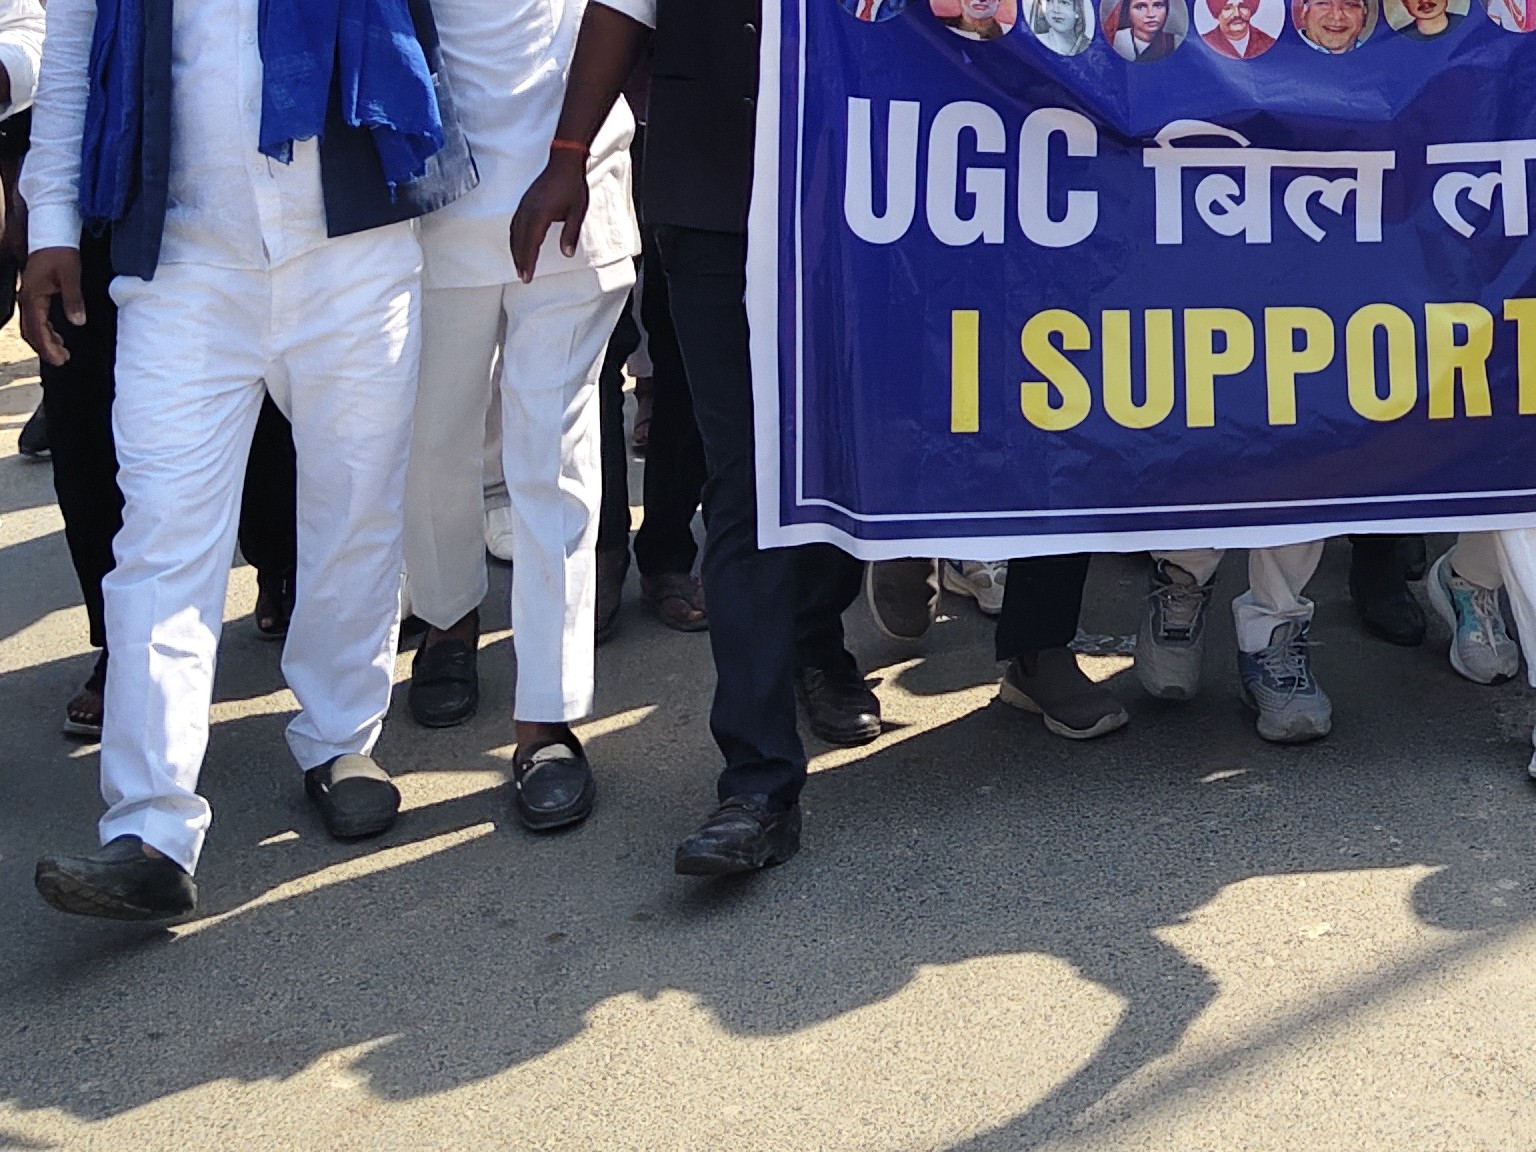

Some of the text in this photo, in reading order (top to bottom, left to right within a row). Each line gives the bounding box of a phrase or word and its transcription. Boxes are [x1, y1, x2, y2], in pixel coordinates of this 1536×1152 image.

[843, 96, 1098, 248] UGC
[1143, 119, 1395, 245] बिल
[950, 309, 980, 433] I
